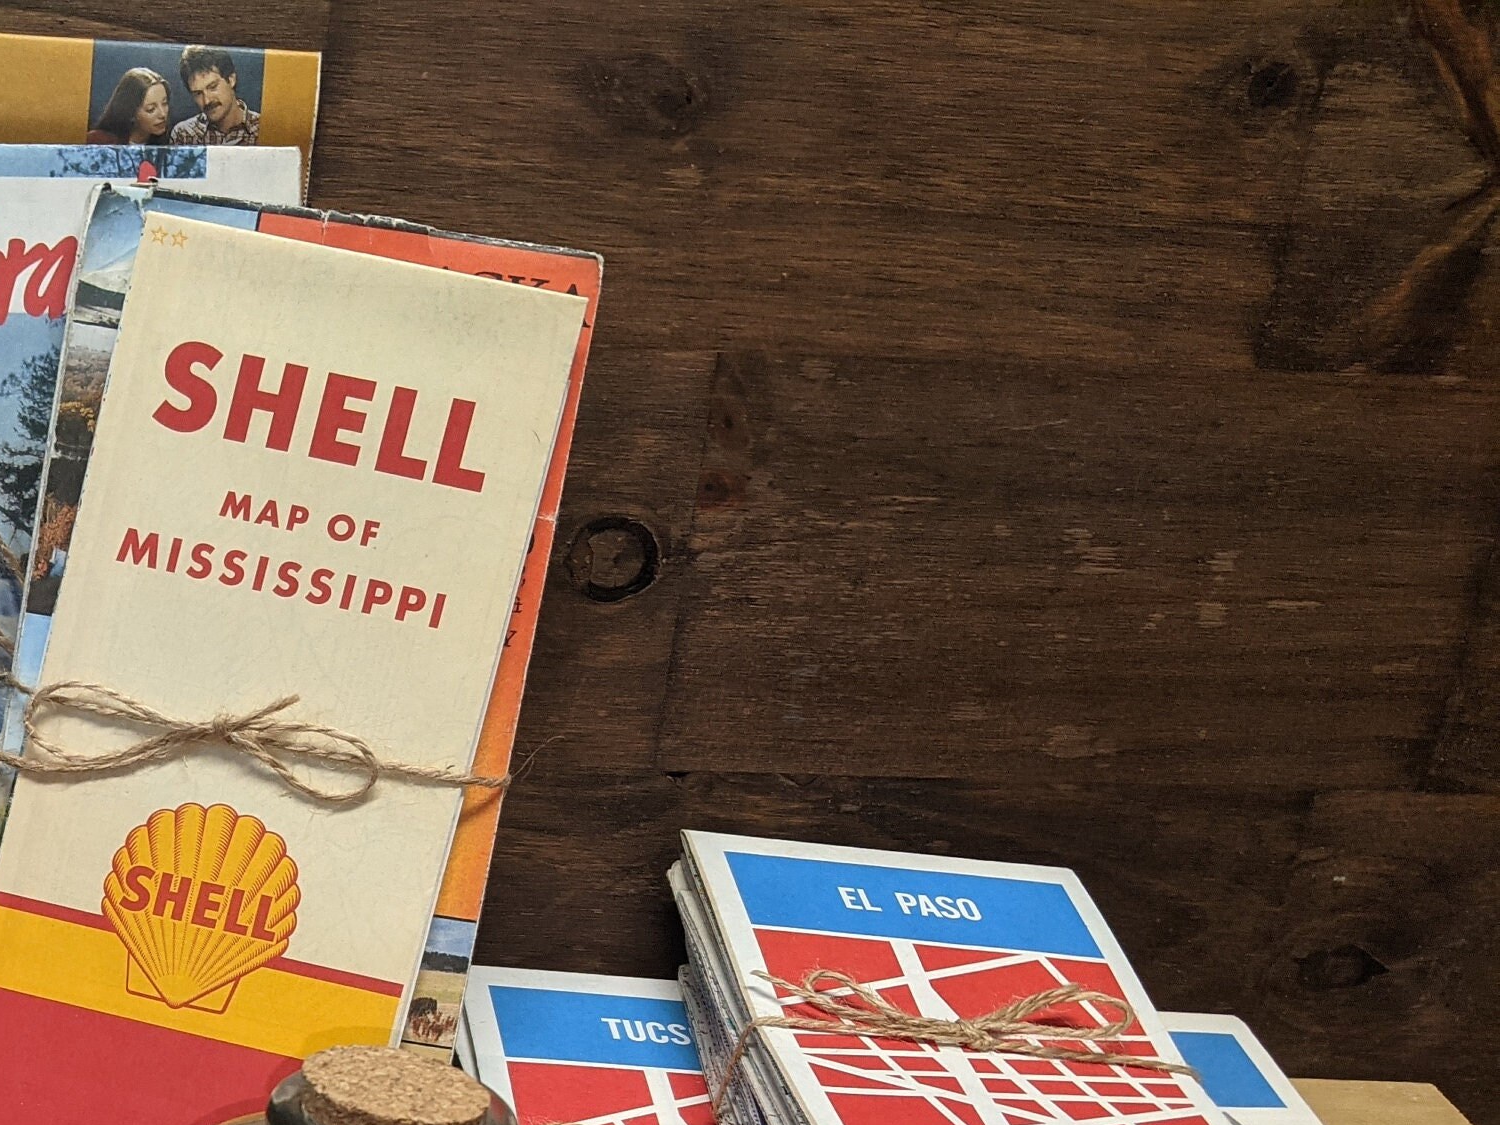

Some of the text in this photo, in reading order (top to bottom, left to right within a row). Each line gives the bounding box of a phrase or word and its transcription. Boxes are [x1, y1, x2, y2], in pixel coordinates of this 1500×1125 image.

[152, 340, 485, 493] SHELL
[218, 489, 382, 548] MAP OF
[115, 527, 447, 630] MISSISSIPPI
[117, 864, 278, 943] SHELL
[837, 886, 983, 922] EL PASO
[601, 1017, 694, 1046] TUCS
